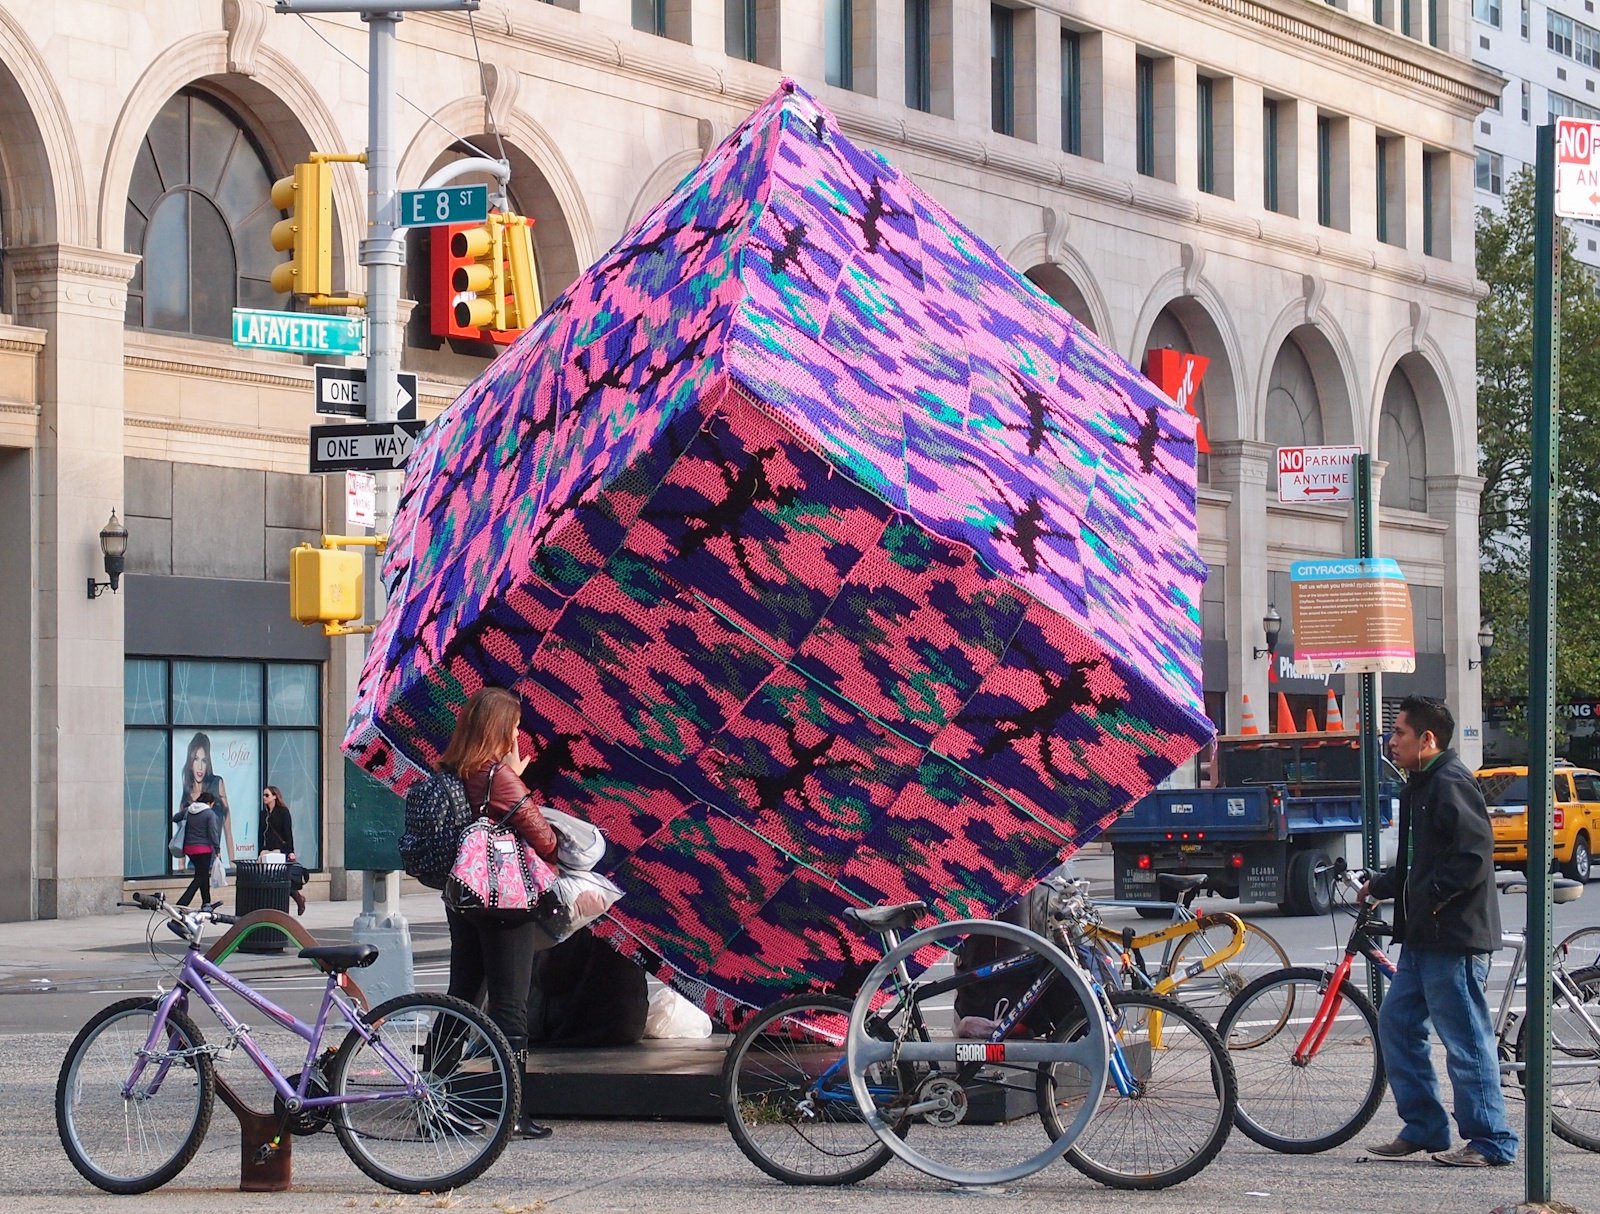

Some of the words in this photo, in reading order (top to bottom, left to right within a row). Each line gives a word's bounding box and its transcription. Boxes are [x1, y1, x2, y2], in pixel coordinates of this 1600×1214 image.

[1561, 125, 1589, 160] NO
[413, 194, 425, 222] E
[436, 192, 450, 221] 8
[460, 190, 473, 206] ST
[237, 314, 329, 348] LAFAYETTE
[347, 323, 360, 338] ST
[330, 382, 359, 402] ONE
[327, 439, 359, 458] ONE
[374, 437, 408, 456] WAY
[1280, 450, 1303, 470] NO
[1293, 473, 1349, 485] ANYTIME
[1298, 564, 1355, 576] CITYRACKS
[235, 843, 256, 852] kmart
[987, 978, 1043, 1043] ALEIGH
